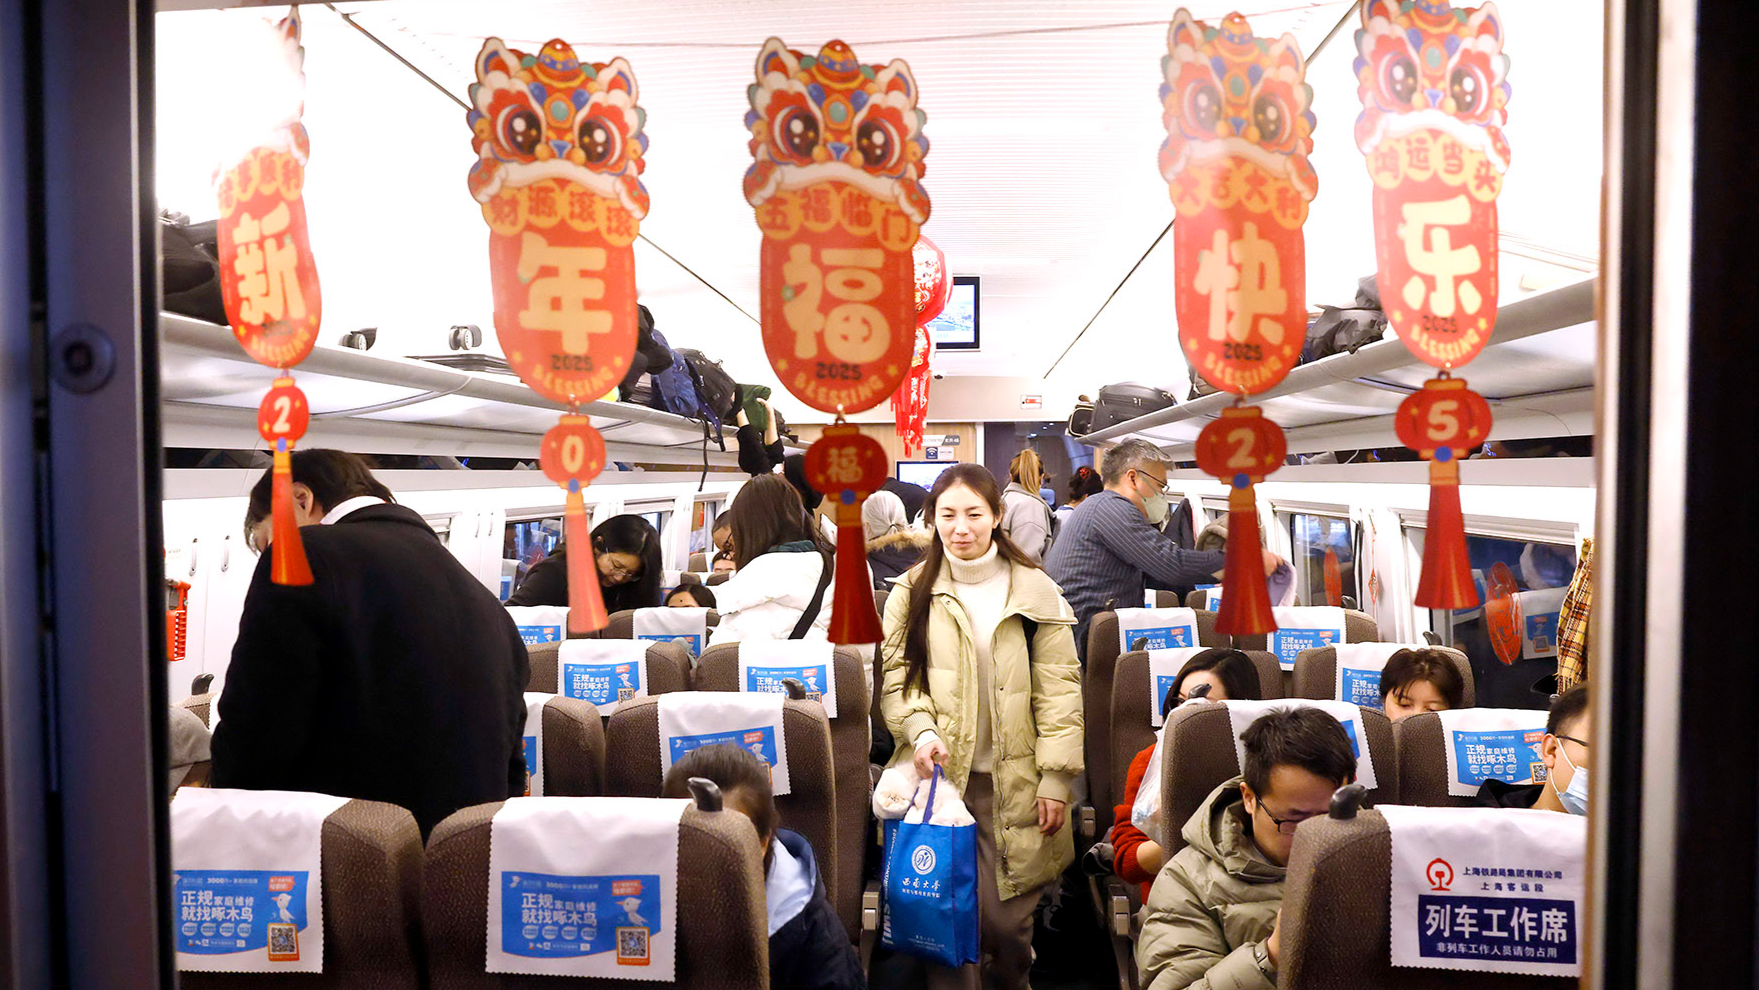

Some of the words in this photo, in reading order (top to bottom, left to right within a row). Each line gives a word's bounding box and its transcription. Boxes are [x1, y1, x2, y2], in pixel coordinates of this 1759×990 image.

[1176, 163, 1301, 221] 大吉大利
[489, 184, 633, 239] 财源滚滚
[763, 184, 911, 243] 五福临门
[232, 202, 306, 326] 新
[1402, 194, 1482, 317] 乐
[517, 231, 614, 356] 年
[1193, 221, 1288, 346] 快
[781, 243, 892, 364] 福
[1410, 324, 1481, 361] BLESSING
[1422, 315, 1459, 334] 2025
[551, 354, 595, 372] 2025
[1203, 351, 1283, 388] BLESSING
[1223, 342, 1264, 361] 2025
[532, 364, 614, 397] BLESSING
[793, 372, 885, 407] BLESSING
[815, 362, 863, 381] 2025
[272, 395, 291, 434] 2
[1427, 399, 1459, 442] 5
[561, 434, 585, 475] 0
[827, 446, 863, 483] 福
[1226, 427, 1257, 469] 2
[1465, 744, 1516, 755] 正规家庭维修
[1467, 754, 1518, 765] 就找啄木鸟
[1462, 866, 1563, 880] 上海铁路局集团有限公司
[1480, 882, 1545, 893] 上海客运段
[180, 906, 254, 922] 就找啄木鸟
[181, 889, 255, 907] 正规家庭维修
[521, 892, 597, 912] 正规家庭维修
[521, 909, 598, 927] 就找啄木鸟
[1425, 904, 1569, 944] 列车工作席
[1436, 942, 1558, 959] 非列车工作人员请勿占用
